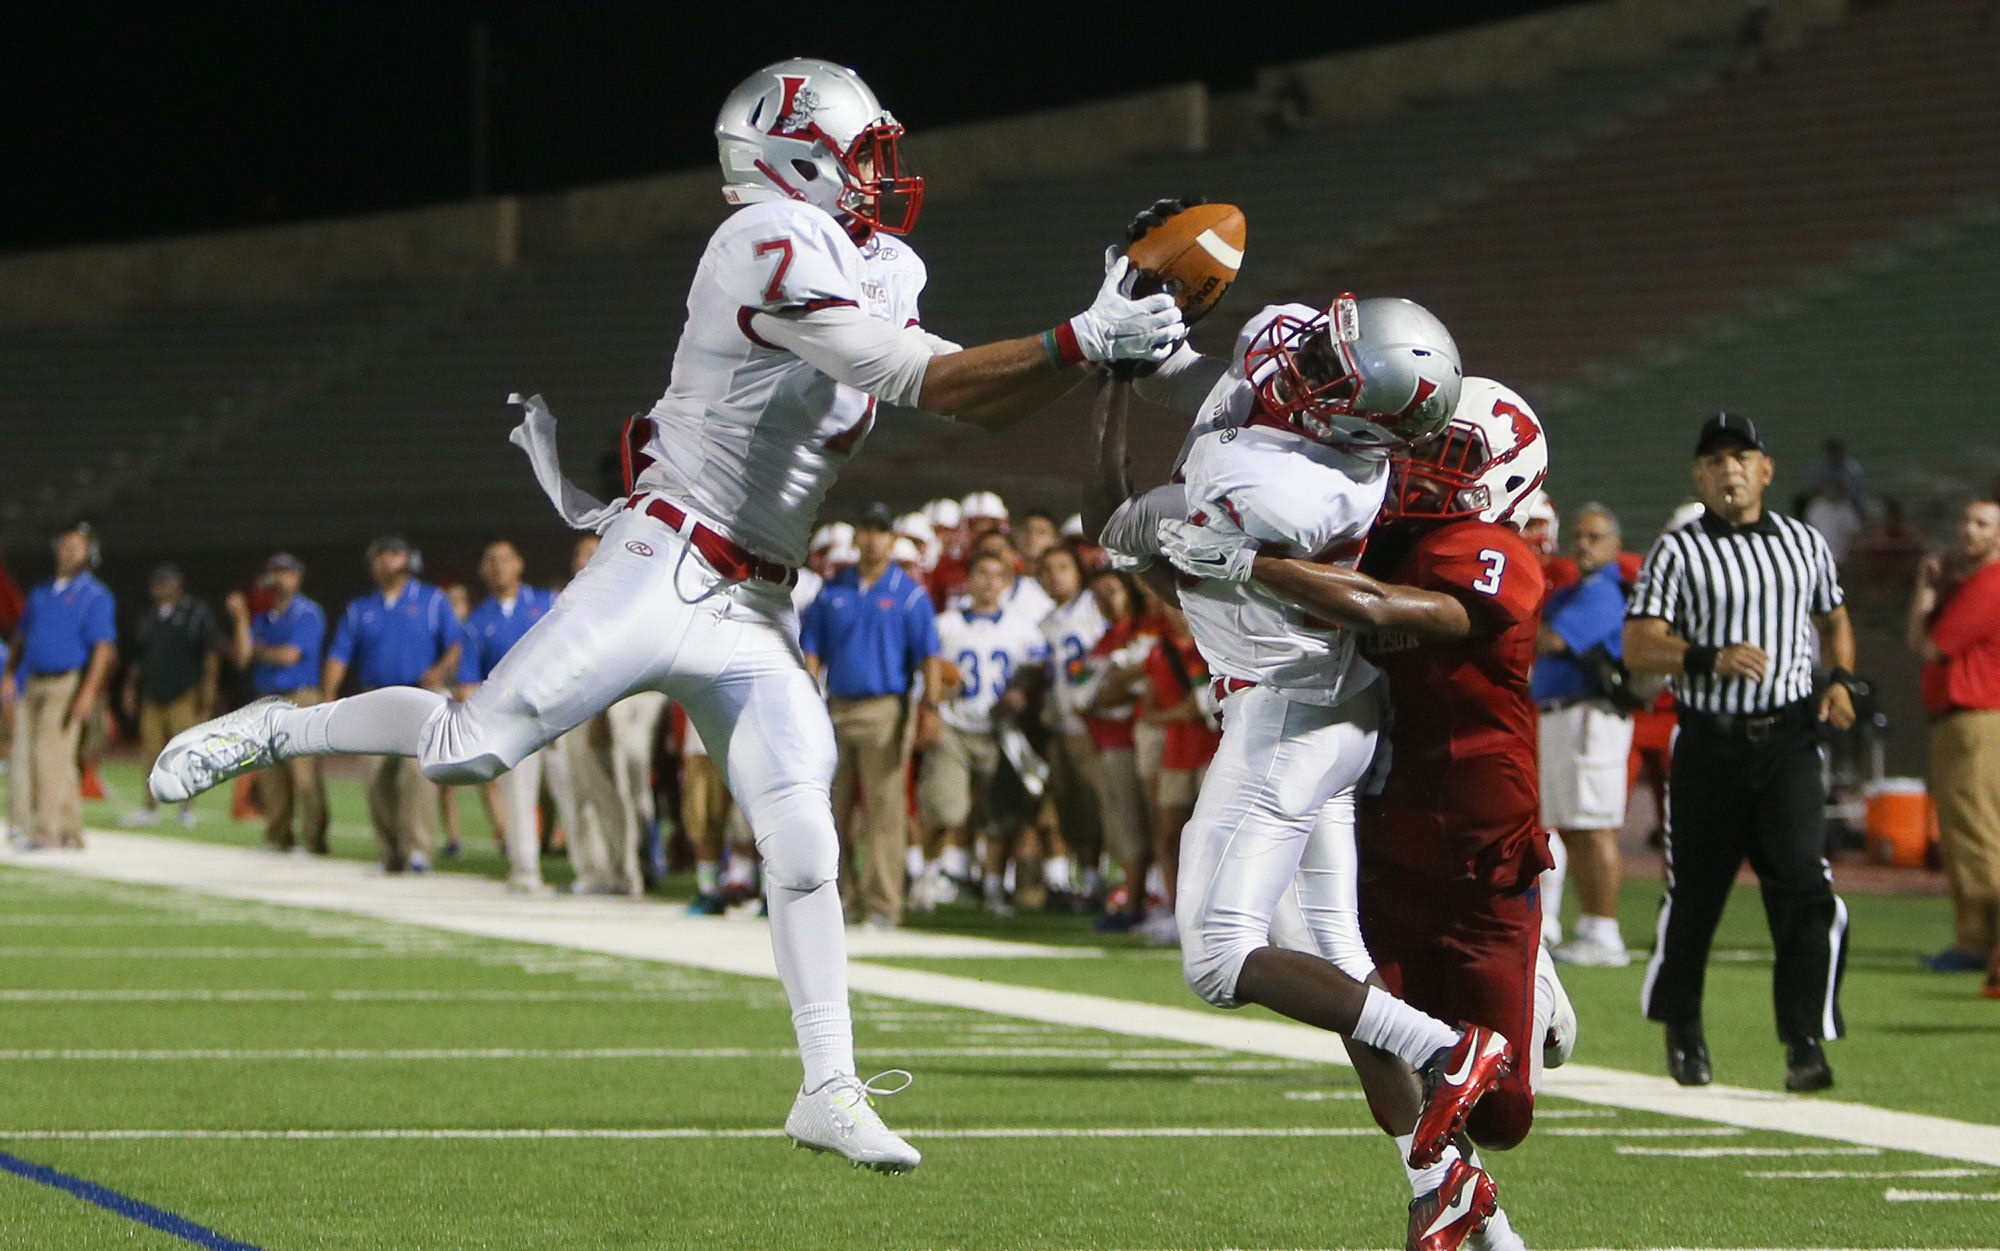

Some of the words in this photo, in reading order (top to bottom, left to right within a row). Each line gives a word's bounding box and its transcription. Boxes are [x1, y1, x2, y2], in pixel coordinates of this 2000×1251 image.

[754, 237, 795, 304] 7
[1472, 548, 1506, 596] 3
[959, 650, 1009, 698] 33
